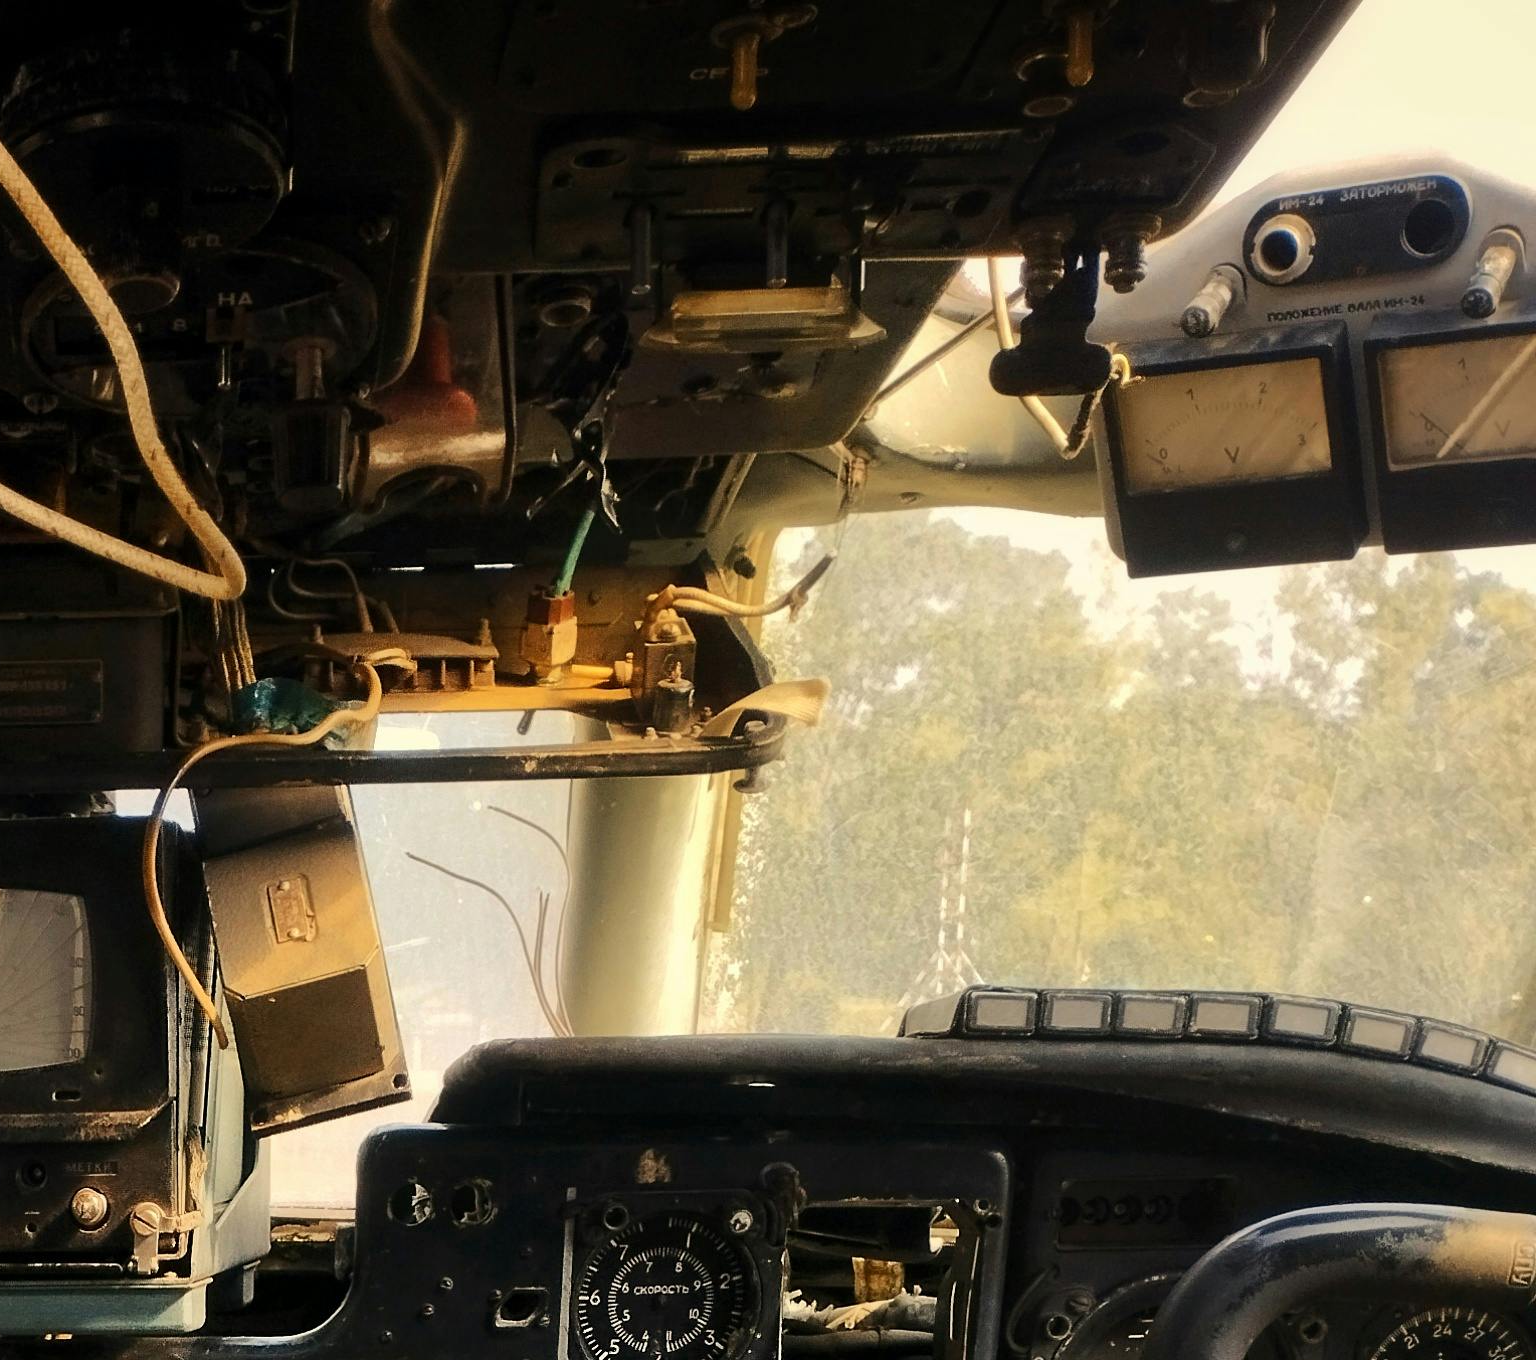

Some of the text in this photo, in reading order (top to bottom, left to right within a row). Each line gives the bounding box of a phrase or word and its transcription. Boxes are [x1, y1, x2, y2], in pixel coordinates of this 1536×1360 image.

[1278, 179, 1437, 211] ИМ-24 ЗАТОРМОЖЕН
[1224, 446, 1241, 464] V
[719, 1273, 731, 1289] 2
[633, 1285, 690, 1296] СКОРОСТЬ
[1464, 1326, 1484, 1343] 27
[609, 1339, 620, 1355] 5
